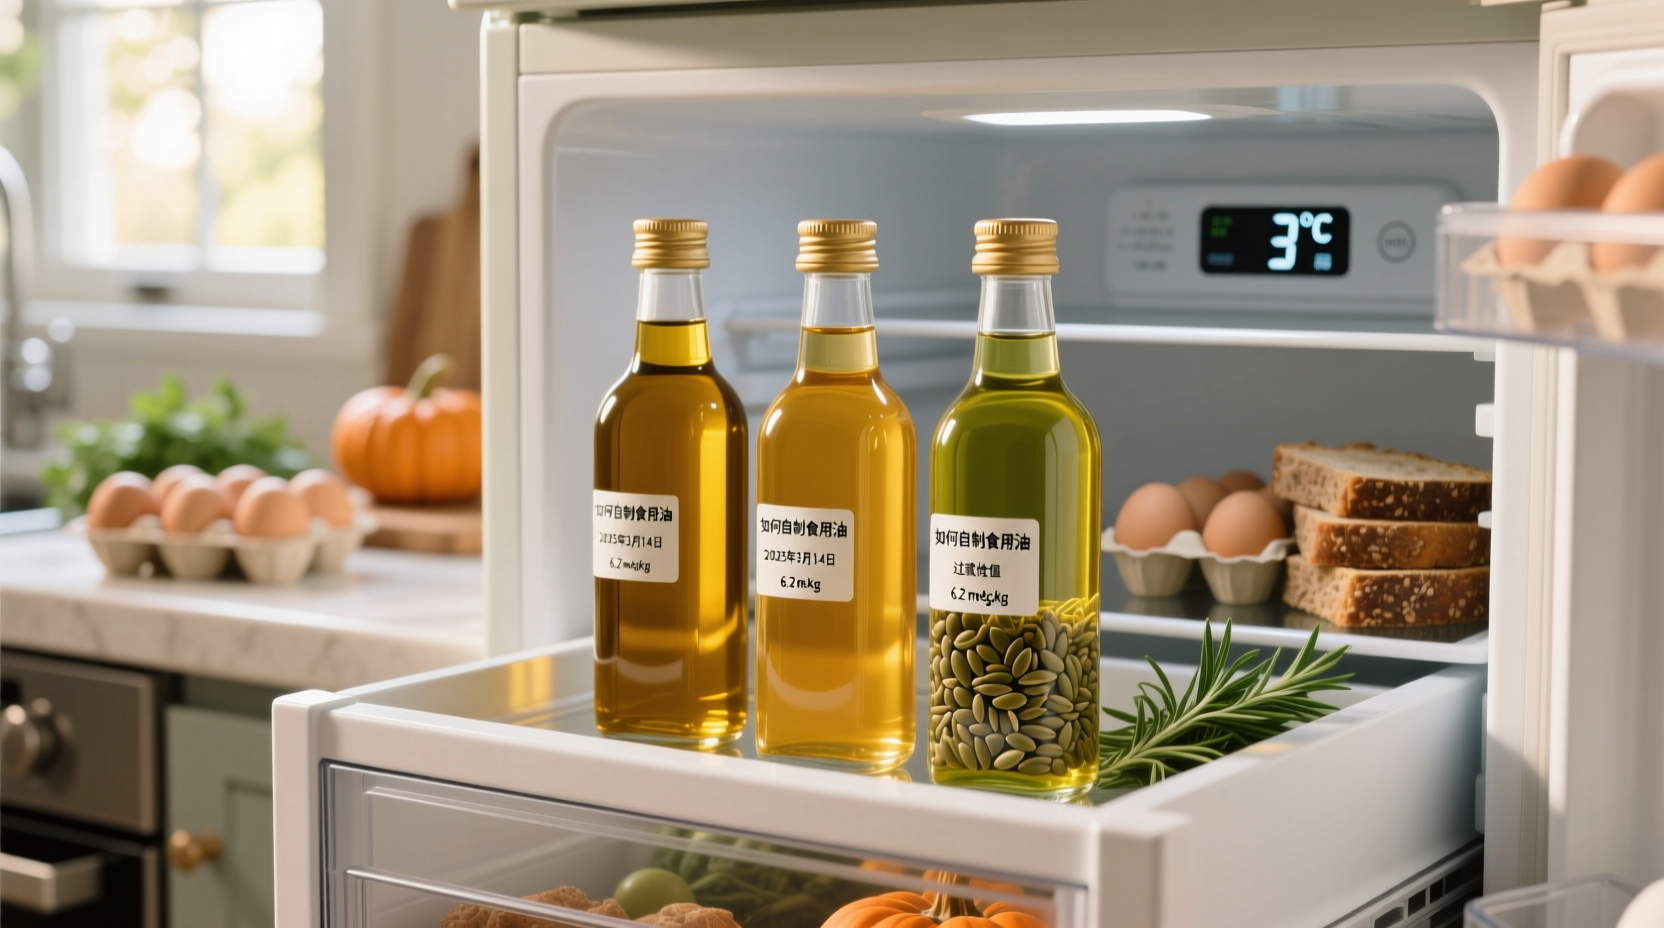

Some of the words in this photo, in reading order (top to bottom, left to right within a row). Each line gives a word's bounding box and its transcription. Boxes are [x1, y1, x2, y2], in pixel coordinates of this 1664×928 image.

[935, 528, 1031, 551] 如何自制食用油
